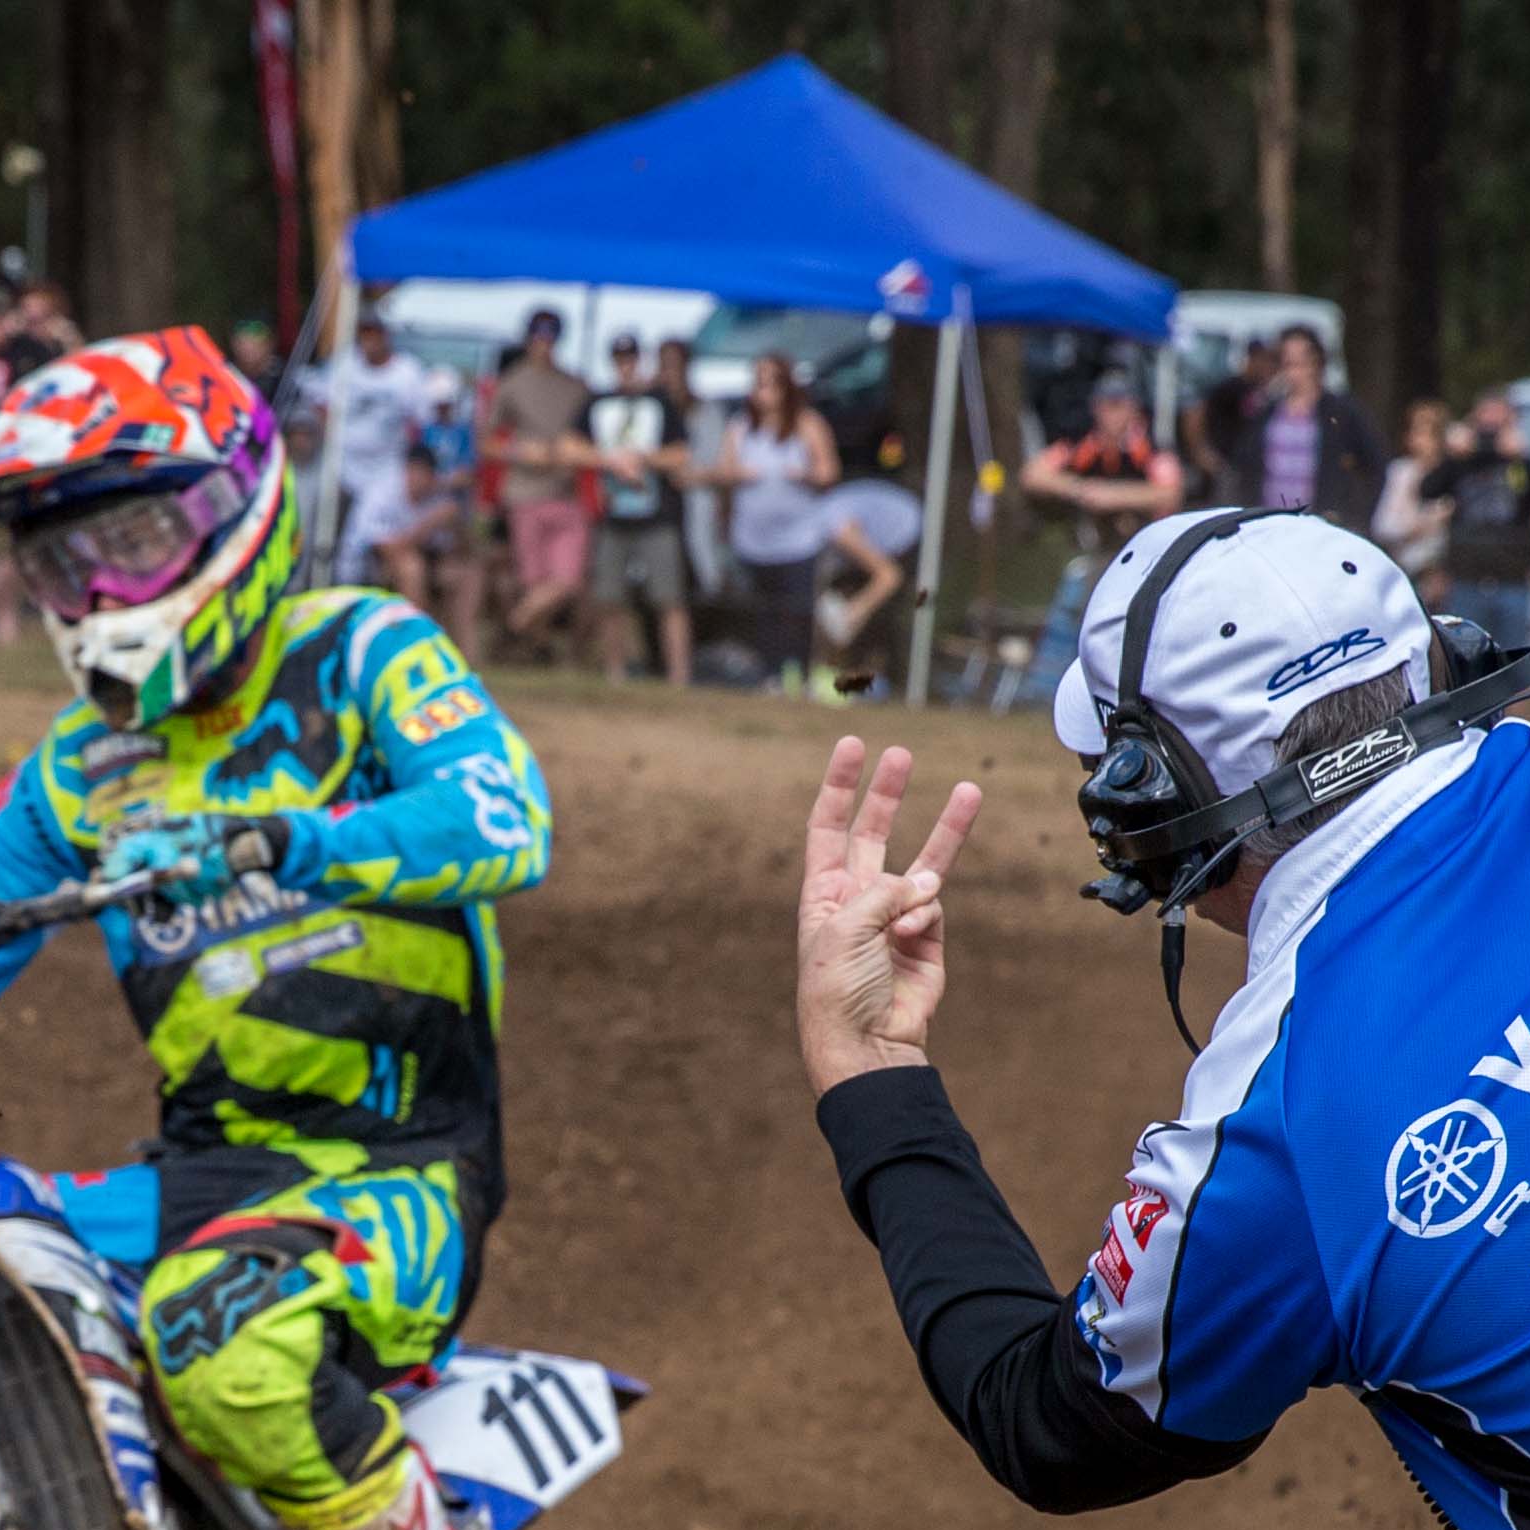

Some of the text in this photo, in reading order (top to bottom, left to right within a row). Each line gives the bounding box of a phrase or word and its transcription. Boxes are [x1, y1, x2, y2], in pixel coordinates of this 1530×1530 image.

[1267, 627, 1386, 694] CDR
[1309, 728, 1404, 780] CDR
[1313, 741, 1405, 788] PERFORMANCE
[481, 1364, 605, 1490] 111
